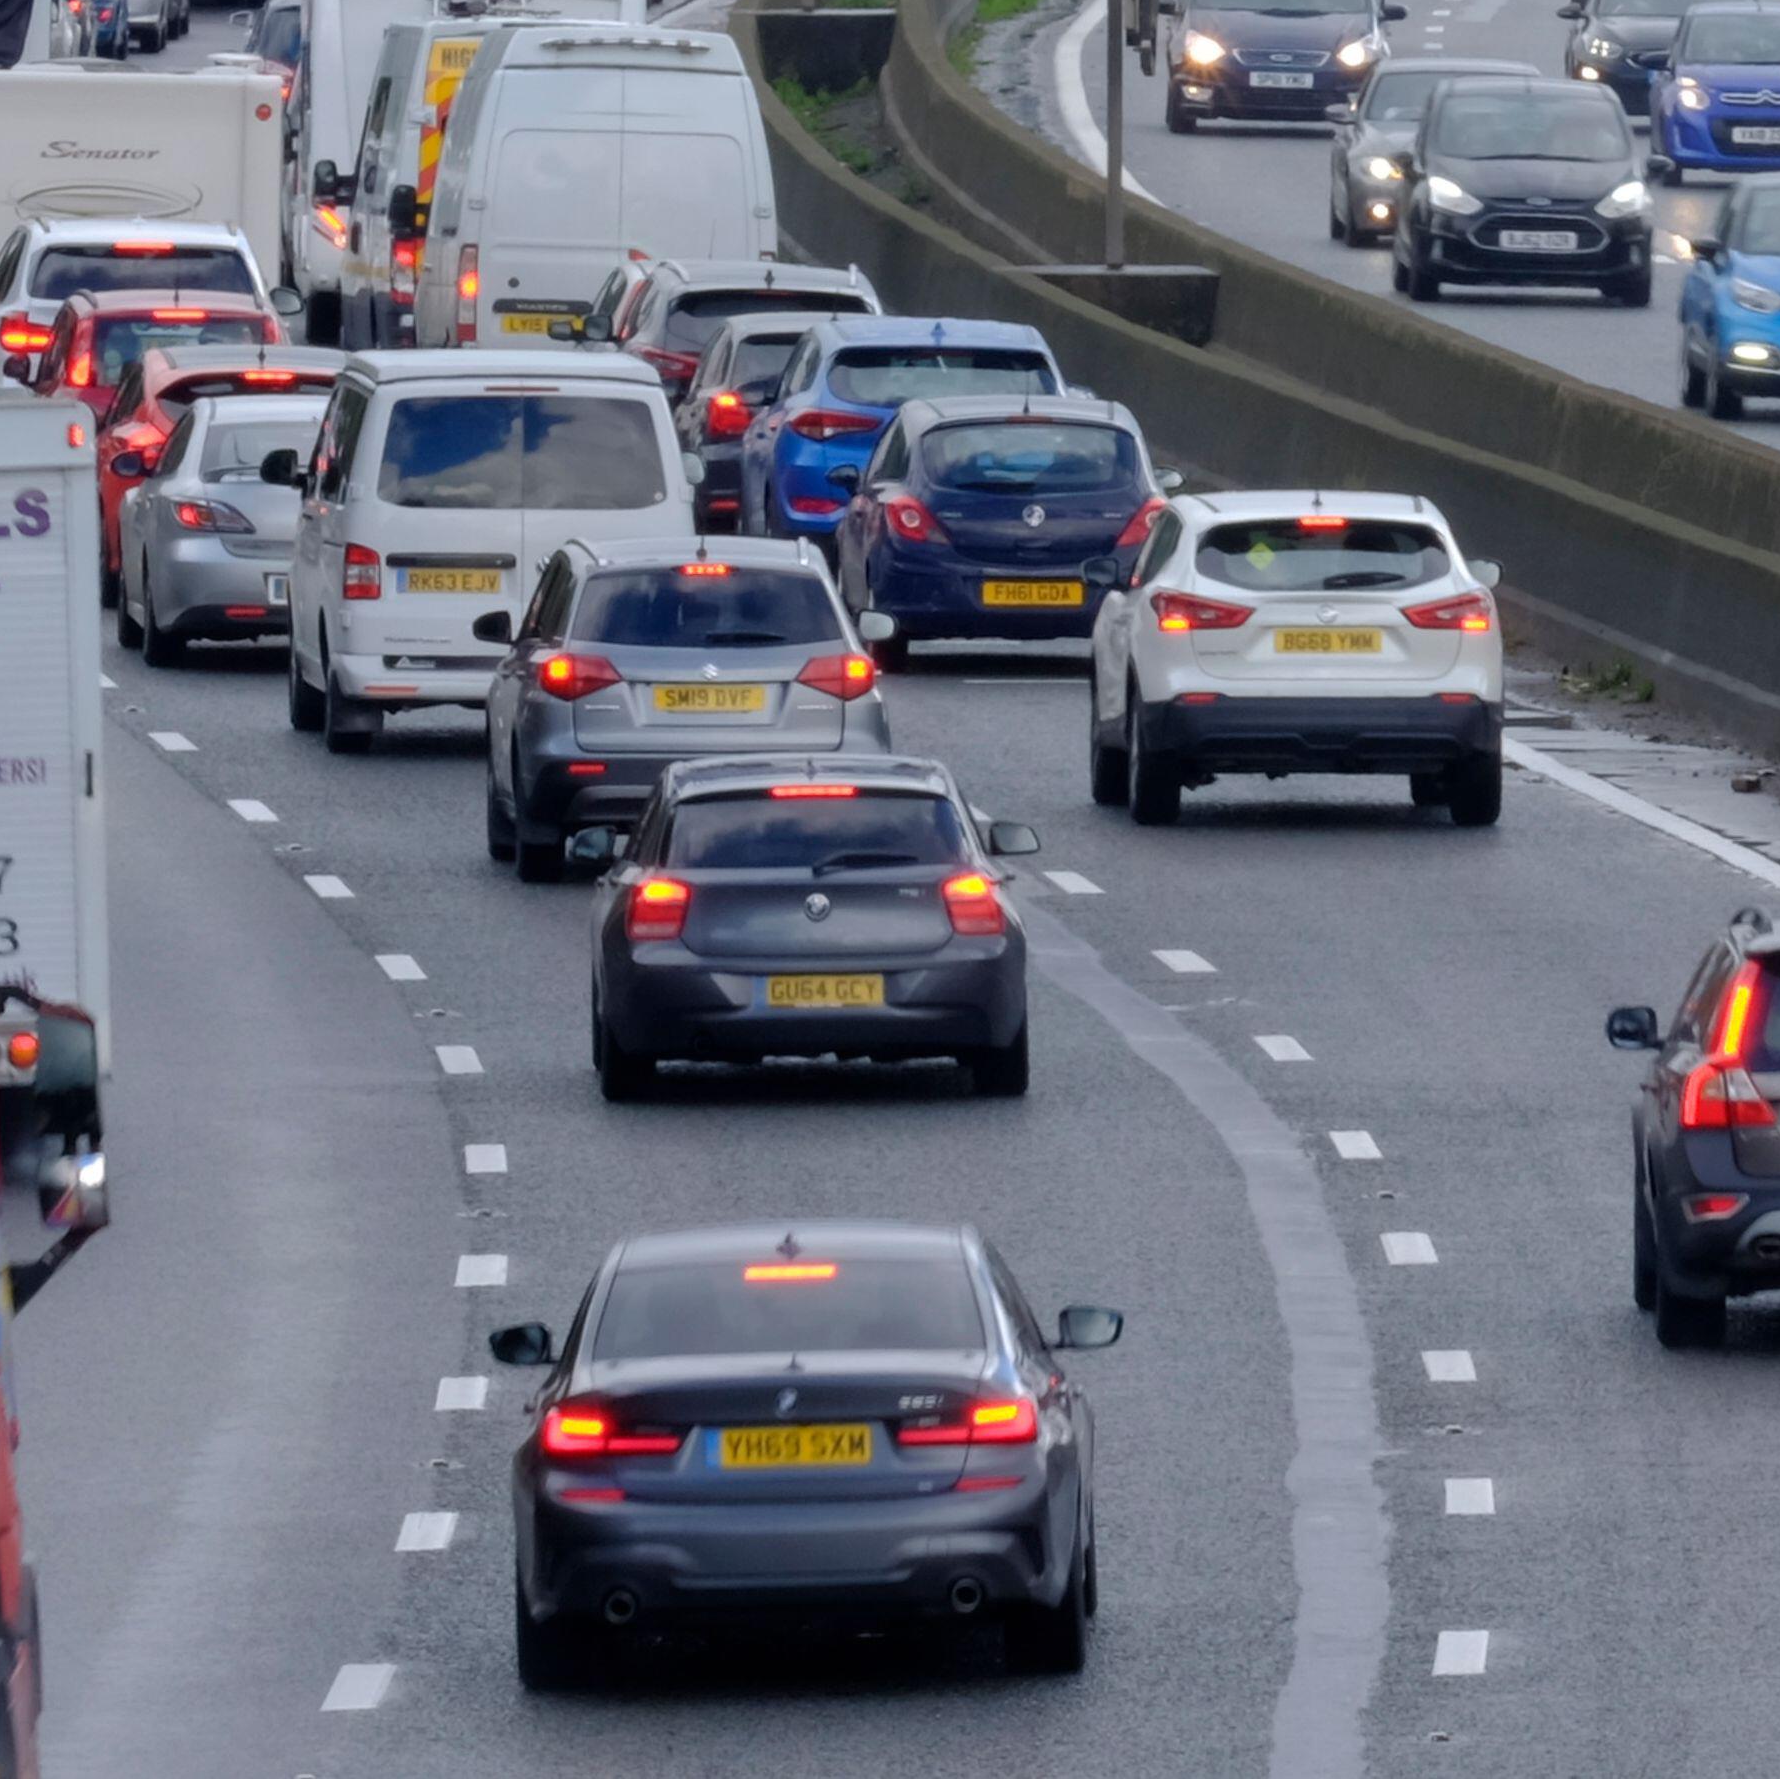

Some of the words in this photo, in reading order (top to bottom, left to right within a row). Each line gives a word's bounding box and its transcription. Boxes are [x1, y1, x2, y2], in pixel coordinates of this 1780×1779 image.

[440, 46, 477, 68] HIG
[40, 139, 160, 163] Senator
[408, 571, 458, 593] RK63
[461, 571, 501, 593] EJV
[993, 583, 1036, 603] FH61
[1278, 631, 1326, 652] BG68
[664, 688, 710, 710] SM19
[714, 688, 752, 710] DVF
[769, 978, 828, 1003] GU64
[836, 978, 881, 1003] GCY
[724, 1431, 801, 1465] YH69
[809, 1431, 868, 1465] SXM
